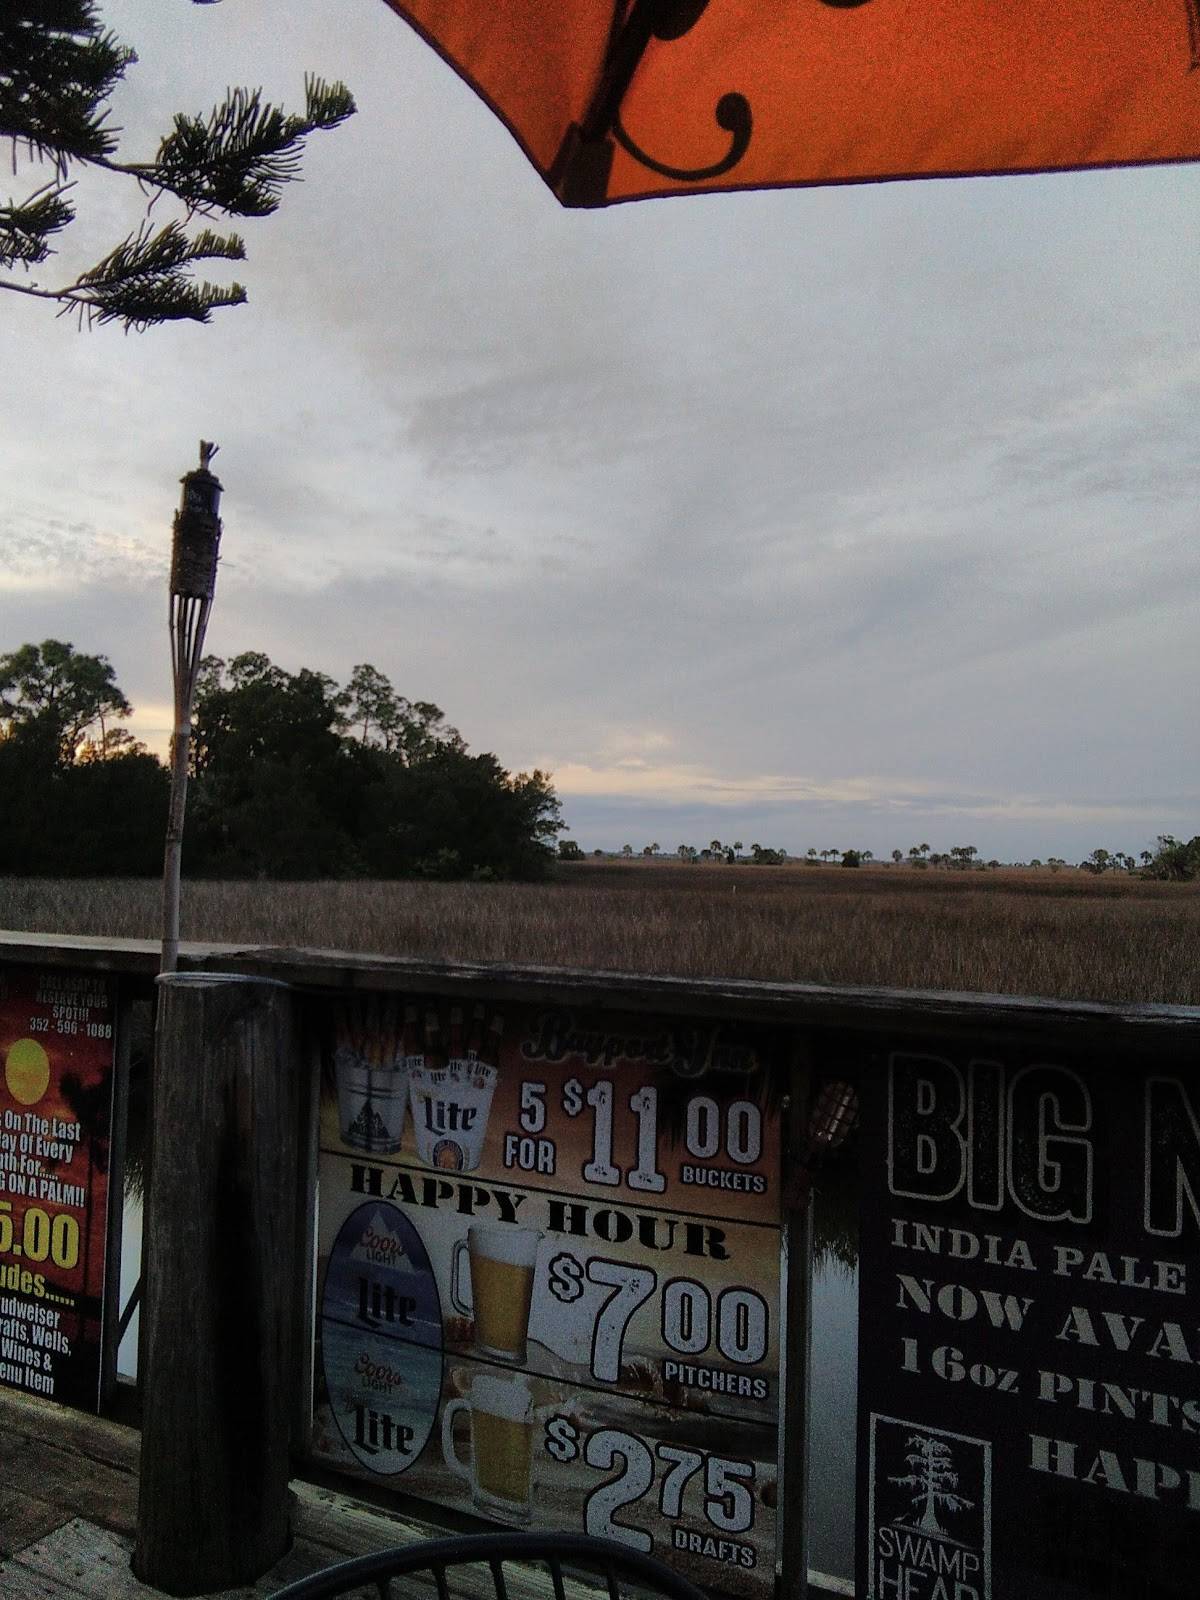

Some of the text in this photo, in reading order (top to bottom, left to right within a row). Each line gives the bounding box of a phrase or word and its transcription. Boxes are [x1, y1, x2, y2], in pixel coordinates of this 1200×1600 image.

[4, 1109, 81, 1141] On The Last
[424, 1096, 477, 1136] Lite
[520, 1082, 546, 1133] 5
[0, 1131, 73, 1163] ay Of Every
[505, 1135, 555, 1174] FOR
[887, 1051, 1093, 1225] BIG
[8, 1173, 26, 1195] ON
[28, 1177, 37, 1198] A
[40, 1180, 84, 1208] PALM!!
[682, 1165, 767, 1194] BUCKETS
[350, 1164, 730, 1261] HAPPY HOUR
[891, 1217, 1187, 1295] INDIA PALE
[357, 1277, 417, 1328] Lite
[896, 1273, 1200, 1364] NOW AVA
[2, 1337, 52, 1372] Wines &
[32, 1324, 72, 1357] Wells,
[25, 1366, 54, 1395] Item
[664, 1361, 768, 1399] PITCHERS
[353, 1405, 414, 1455] Lite
[674, 1528, 755, 1568] DRAFTS
[878, 1526, 980, 1581] SWAMP
